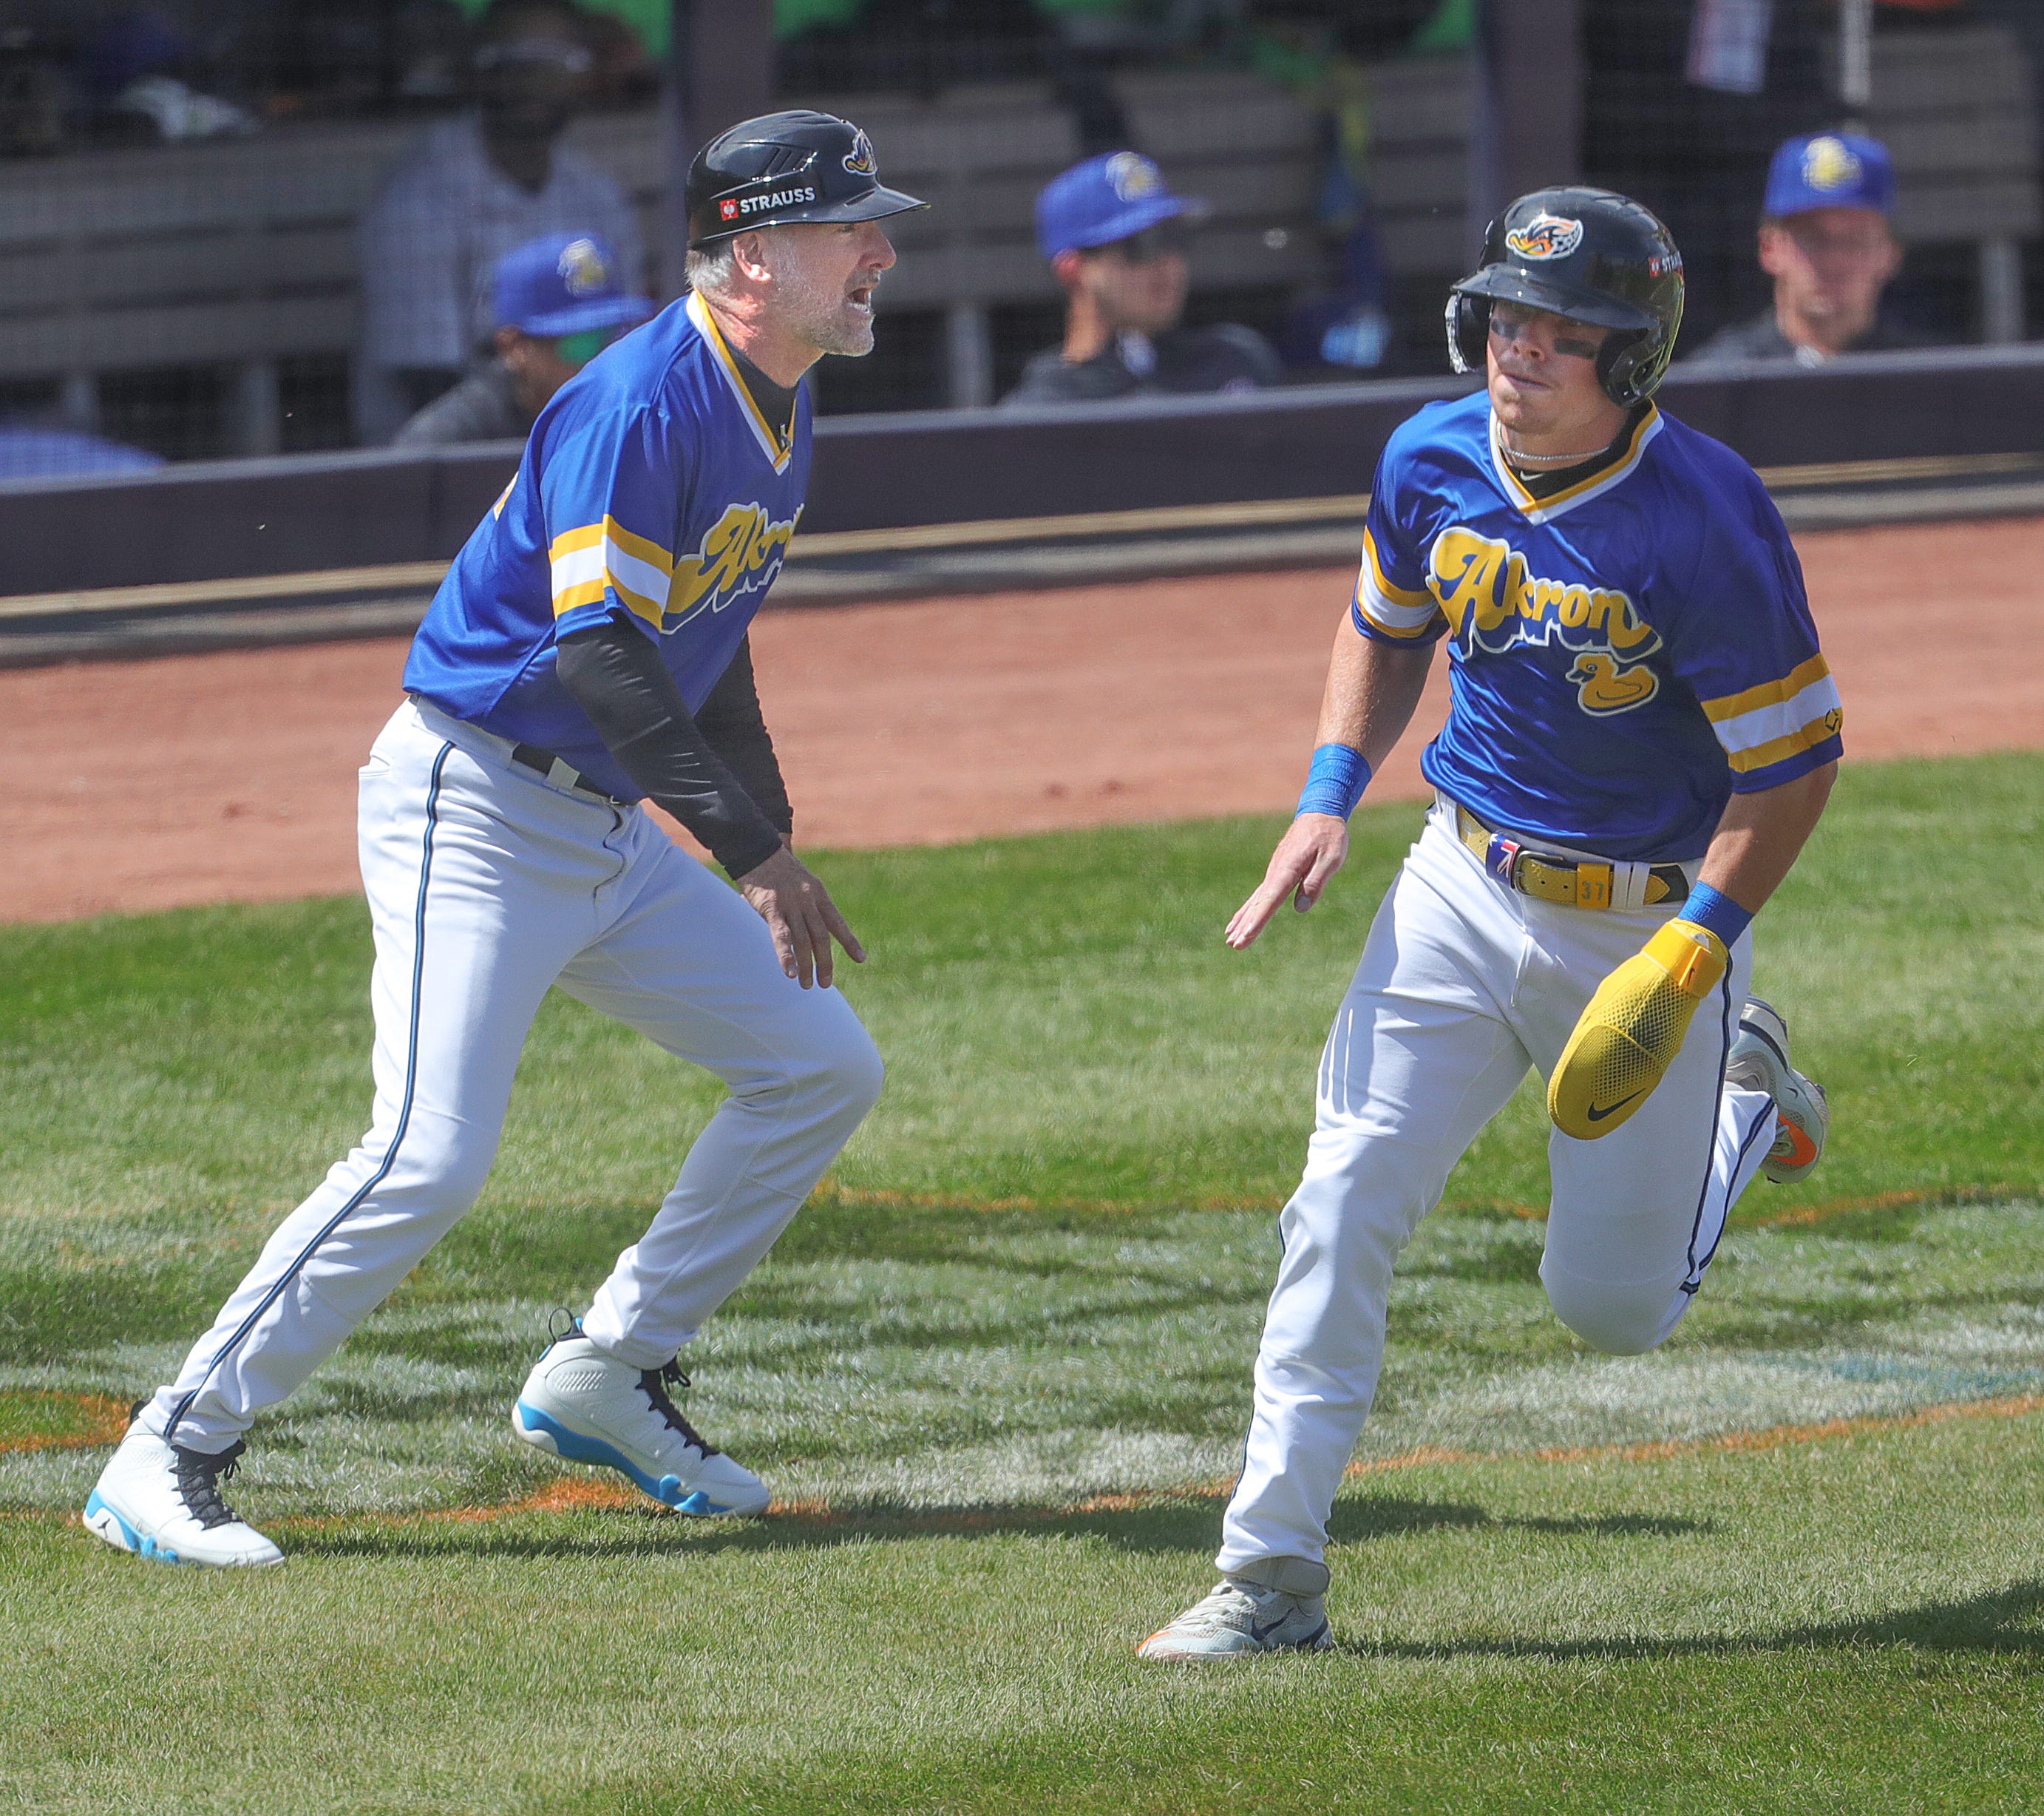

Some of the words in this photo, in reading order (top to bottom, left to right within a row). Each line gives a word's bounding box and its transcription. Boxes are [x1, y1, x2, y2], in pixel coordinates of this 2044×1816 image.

[740, 187, 815, 213] STRAUSS
[661, 501, 804, 634] Akr
[1426, 526, 1663, 663] Akron
